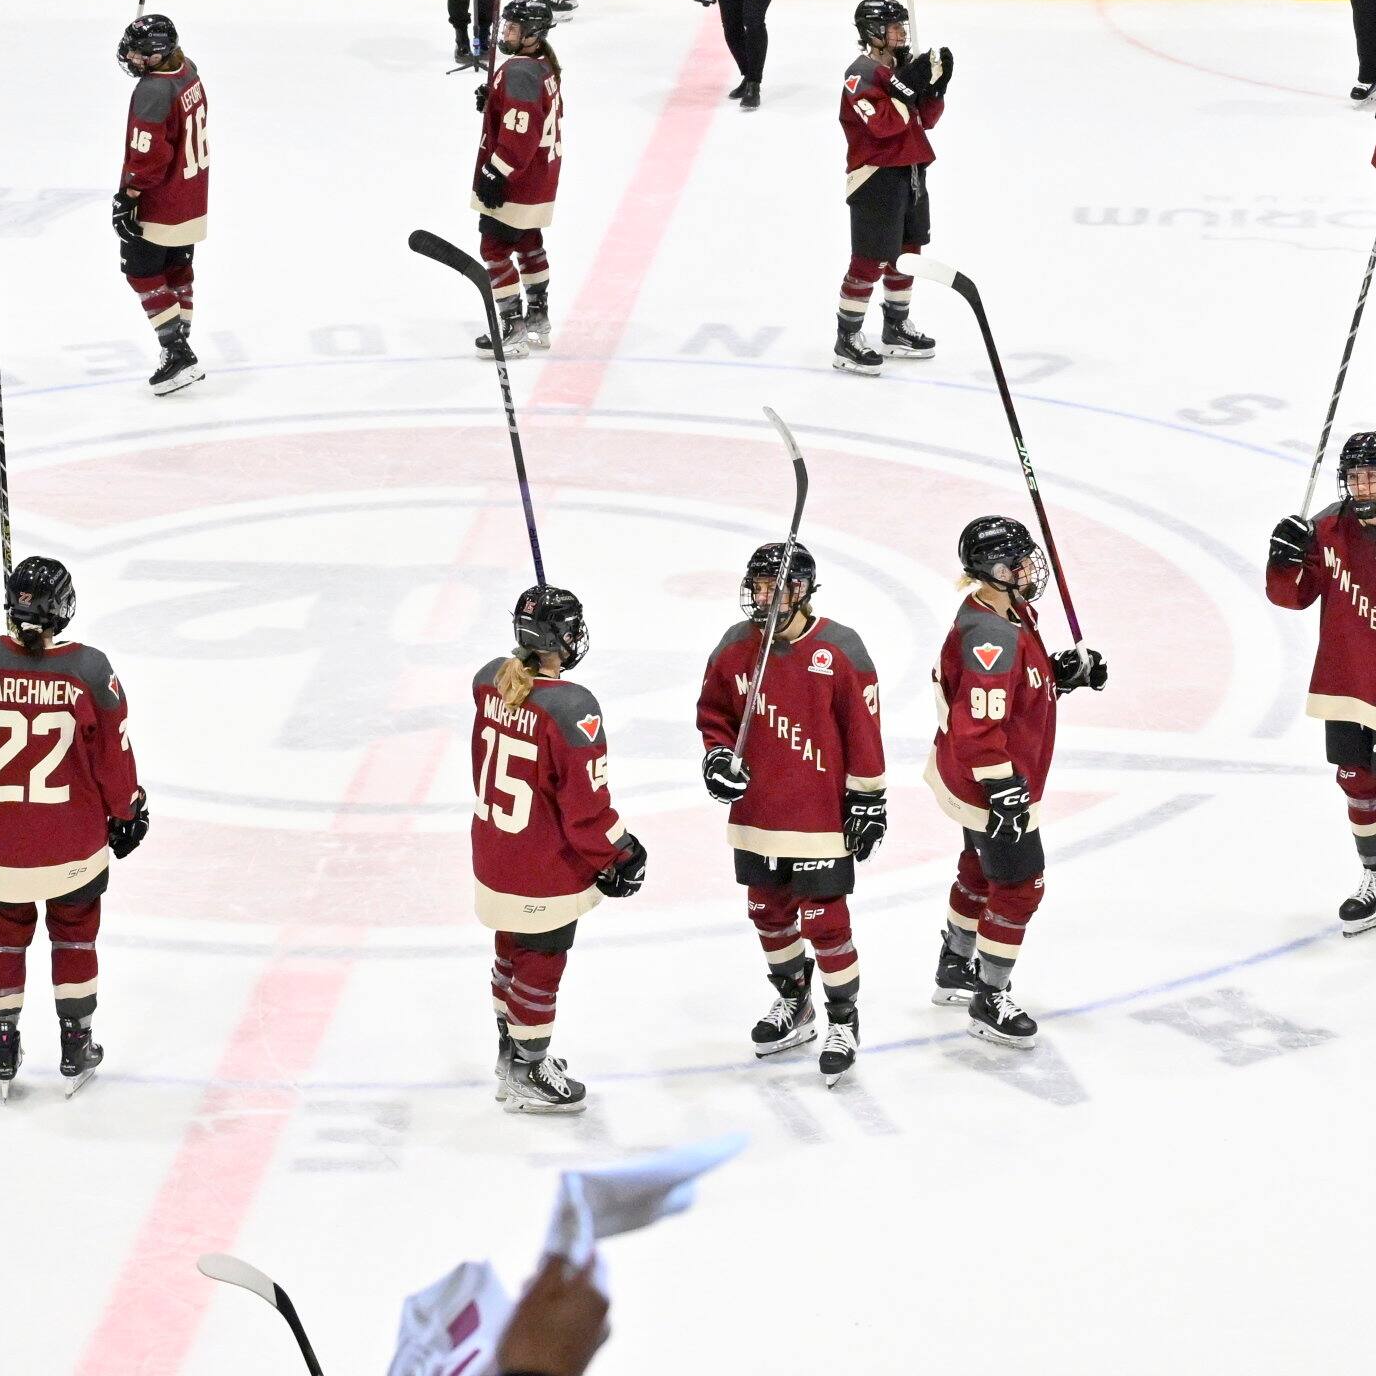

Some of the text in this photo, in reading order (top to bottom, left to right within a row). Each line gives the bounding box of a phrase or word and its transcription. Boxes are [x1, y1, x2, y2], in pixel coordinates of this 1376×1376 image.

[502, 107, 530, 134] 43
[130, 127, 153, 154] 16
[970, 687, 1007, 721] 96
[484, 693, 539, 737] MURPHY
[734, 671, 827, 773] MNTRÉAL
[474, 725, 539, 835] 15
[586, 753, 609, 793] 15
[1339, 768, 1357, 781] SP
[1003, 793, 1031, 806] CC
[67, 866, 88, 880] SP
[791, 859, 836, 873] CCM
[522, 904, 547, 915] SP
[747, 900, 766, 912] SP
[804, 907, 825, 921] SP
